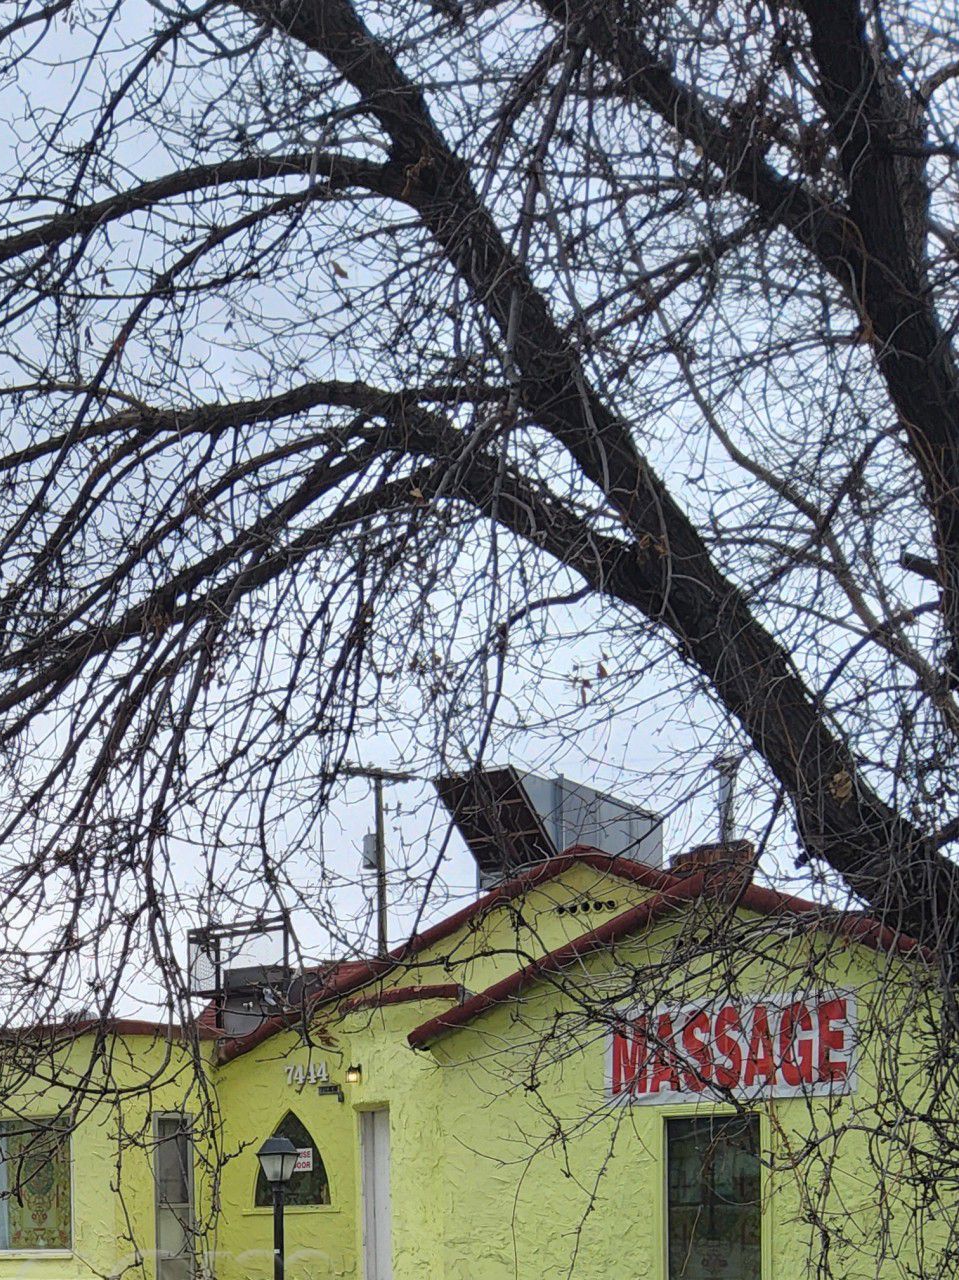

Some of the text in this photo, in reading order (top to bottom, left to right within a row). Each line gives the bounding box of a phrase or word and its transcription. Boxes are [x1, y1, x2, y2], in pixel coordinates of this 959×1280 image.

[612, 999, 847, 1094] MASSAGE
[285, 1060, 329, 1085] 7444
[295, 1161, 311, 1169] OOR
